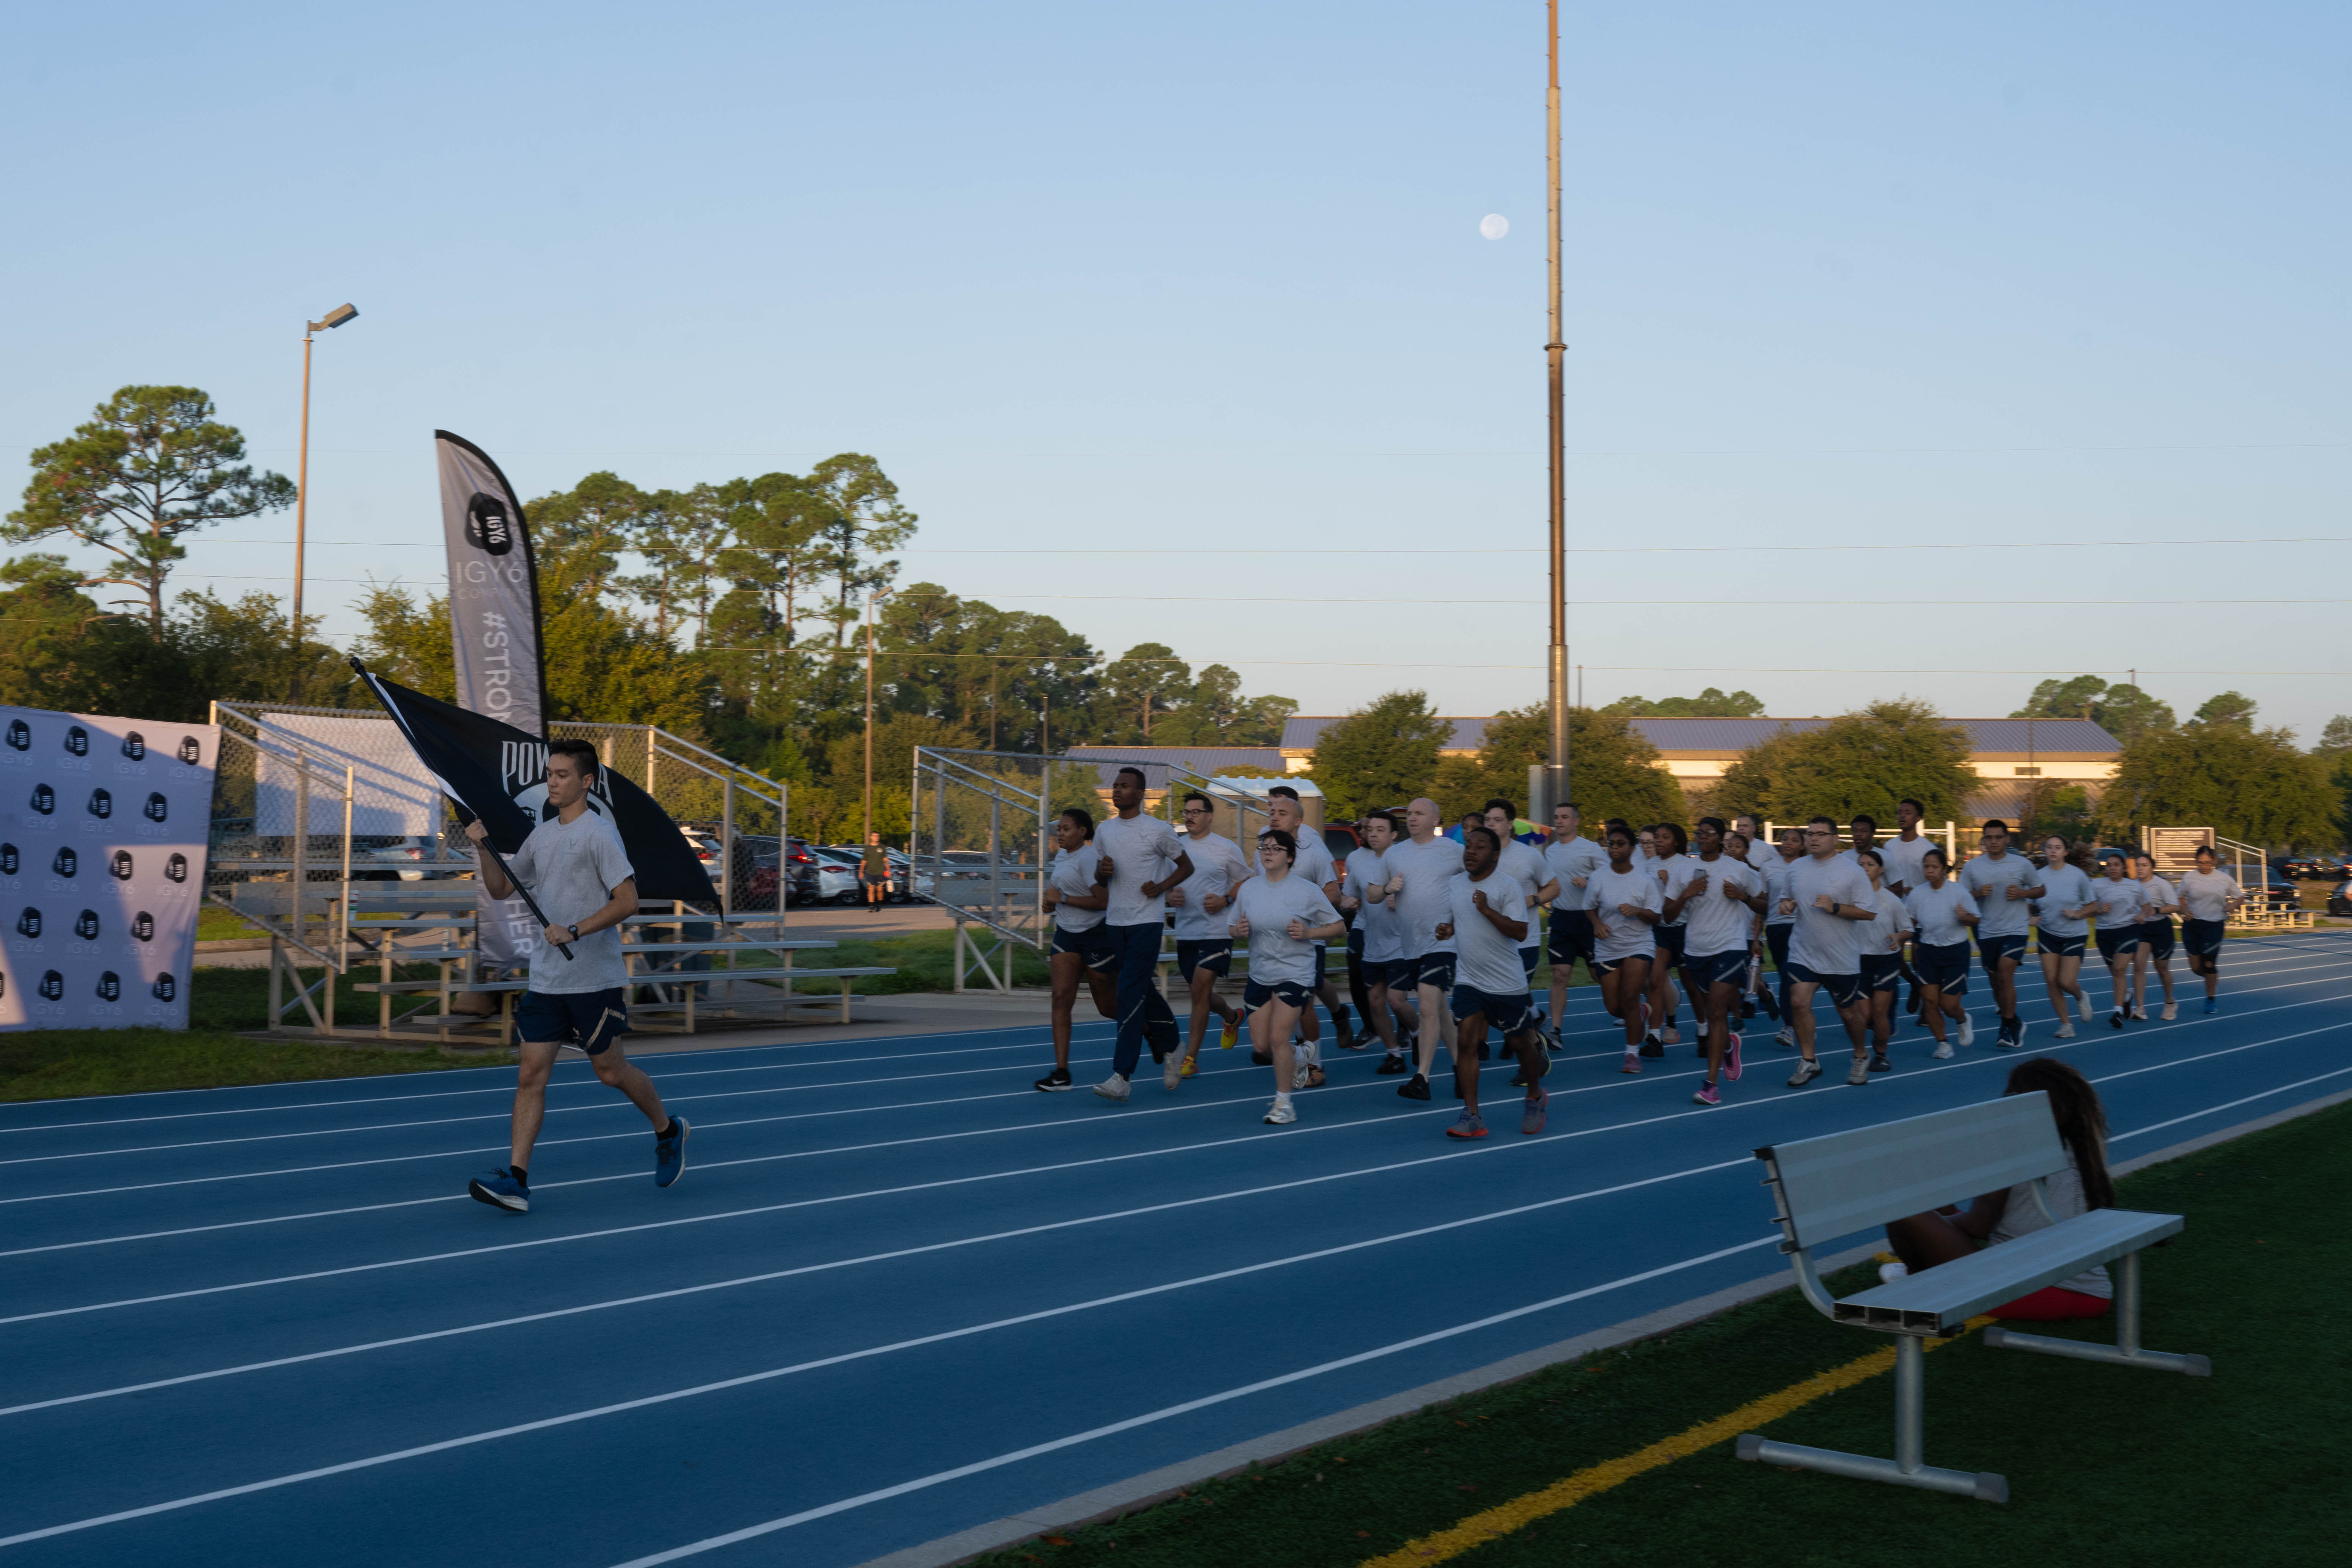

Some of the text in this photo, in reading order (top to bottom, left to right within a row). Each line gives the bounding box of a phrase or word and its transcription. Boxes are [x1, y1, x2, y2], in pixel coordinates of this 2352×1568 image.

[486, 516, 508, 544] IGY6
[456, 561, 525, 584] IGY6
[17, 732, 28, 745] IGY6
[76, 738, 85, 750] IGY6
[133, 742, 142, 755] IGY6
[188, 747, 197, 760] IGY6
[42, 796, 52, 809] IGY6
[99, 800, 108, 813] IGY6
[155, 804, 164, 816] IGY6
[6, 855, 16, 868] IGY6
[64, 859, 74, 872] IGY6
[121, 862, 130, 874] IGY6
[175, 864, 185, 877] IGY6
[29, 919, 38, 932] IGY6
[86, 921, 96, 934] IGY6
[141, 923, 151, 936] IGY6
[50, 981, 60, 995] IGY6
[108, 983, 117, 996] IGY6
[163, 983, 172, 996] IGY6
